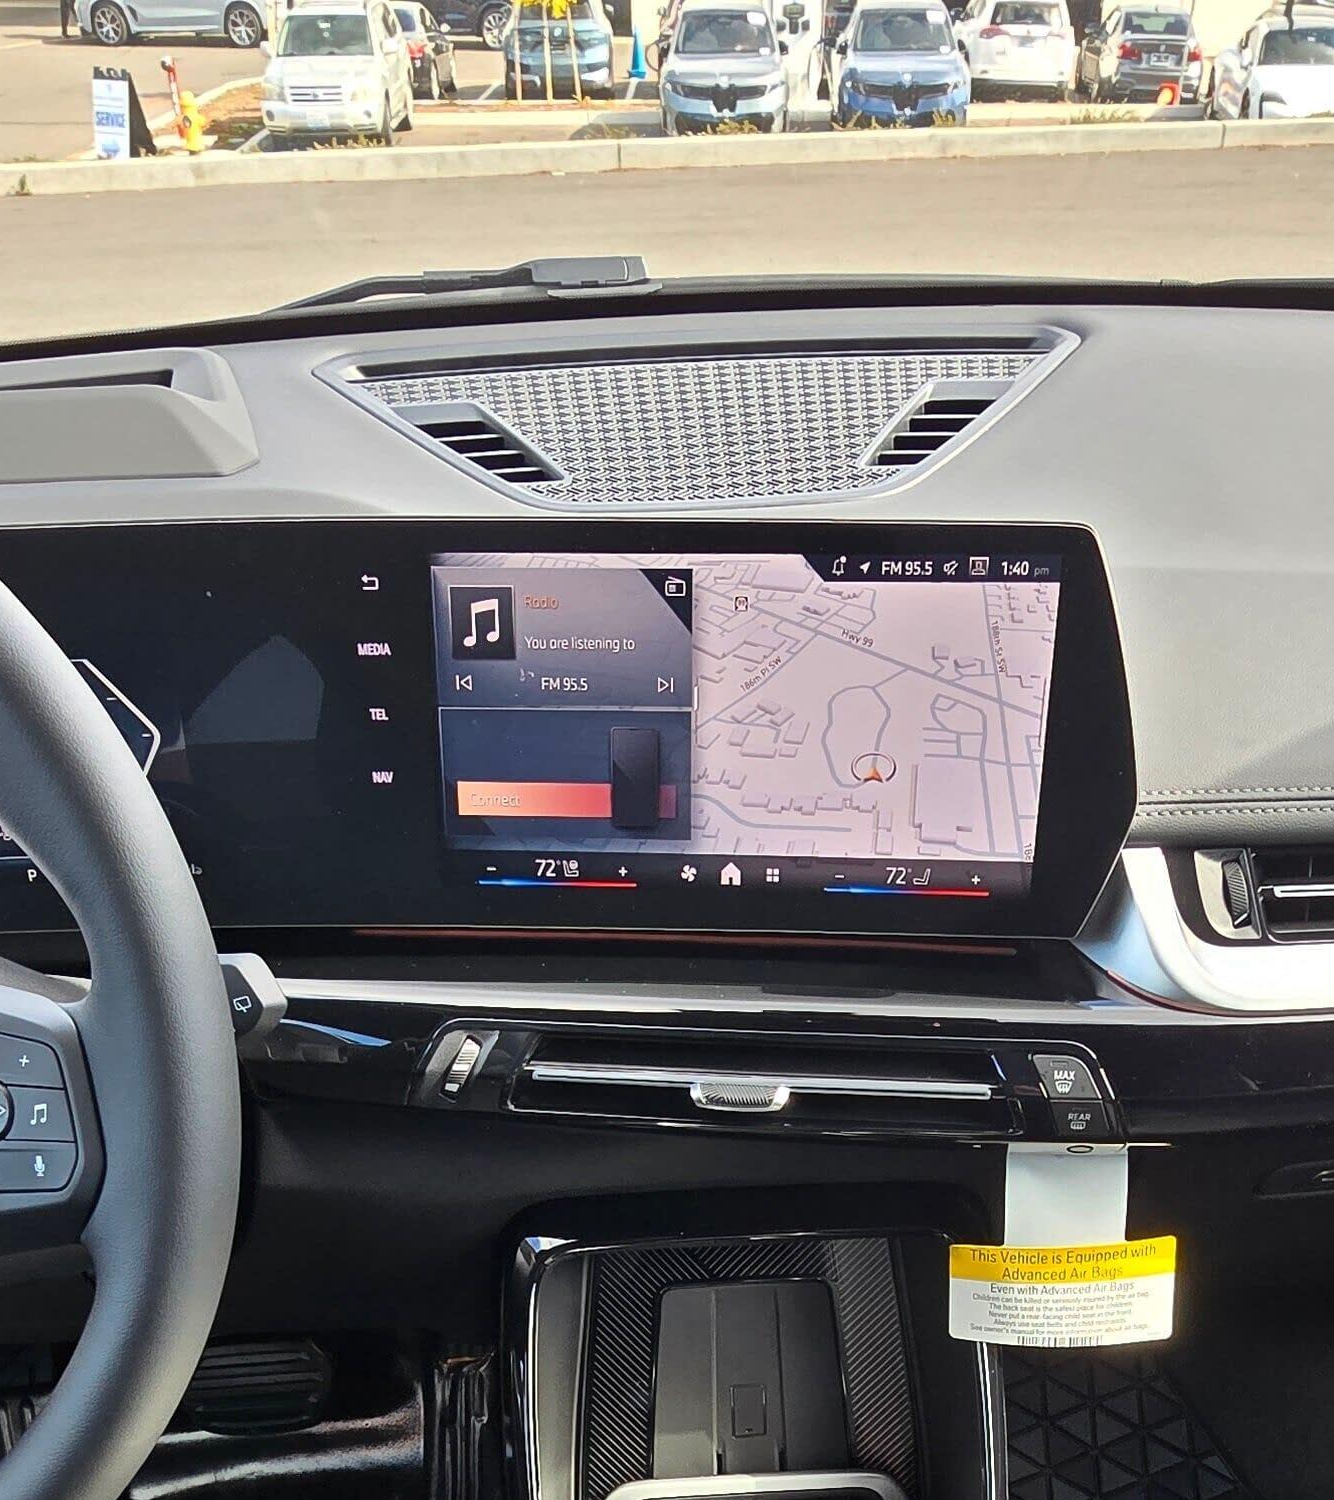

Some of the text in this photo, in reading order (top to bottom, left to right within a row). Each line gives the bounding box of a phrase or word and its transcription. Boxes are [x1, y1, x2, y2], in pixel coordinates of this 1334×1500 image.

[96, 112, 125, 128] SERVICE
[881, 561, 933, 576] FM 95.5
[1001, 561, 1050, 578] 1:40 pm
[524, 596, 559, 610] Radio
[524, 636, 635, 653] You are listening to
[841, 628, 874, 648] Hwy 99
[357, 643, 391, 656] MEDIA
[541, 677, 588, 691] FM 95.5
[369, 708, 389, 721] TEL
[372, 771, 394, 784] NAV
[470, 793, 521, 808] Connect
[27, 869, 37, 882] P
[1053, 1070, 1076, 1081] MAX
[1067, 1112, 1091, 1121] REAR
[970, 1244, 1156, 1265] This Vehicle is Equipped with
[1002, 1265, 1124, 1281] Advanced Air Bags
[990, 1281, 1135, 1295] Even with Advanced Air Bags
[972, 1293, 1000, 1302] Children
